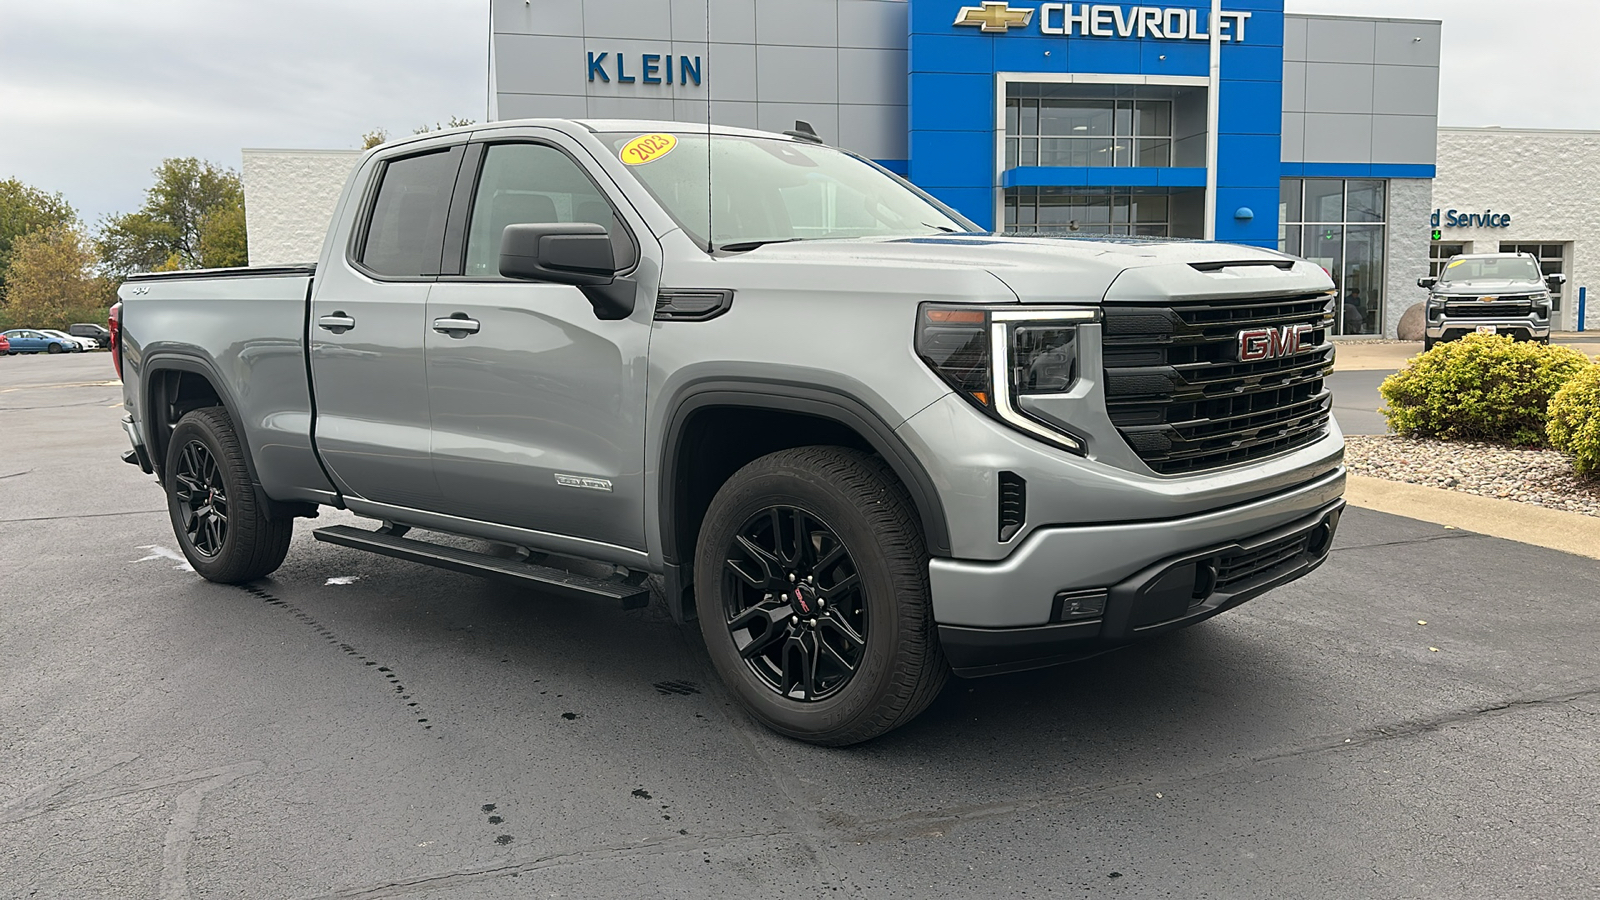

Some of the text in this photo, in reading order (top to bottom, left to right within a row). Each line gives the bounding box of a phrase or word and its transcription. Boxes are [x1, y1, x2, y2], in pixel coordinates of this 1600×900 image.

[1040, 2, 1252, 42] CHEVROLET
[587, 51, 702, 86] KLEIN
[629, 135, 670, 161] 2023
[1446, 209, 1511, 228] Service
[1238, 323, 1313, 362] GMC
[794, 587, 810, 613] GMC
